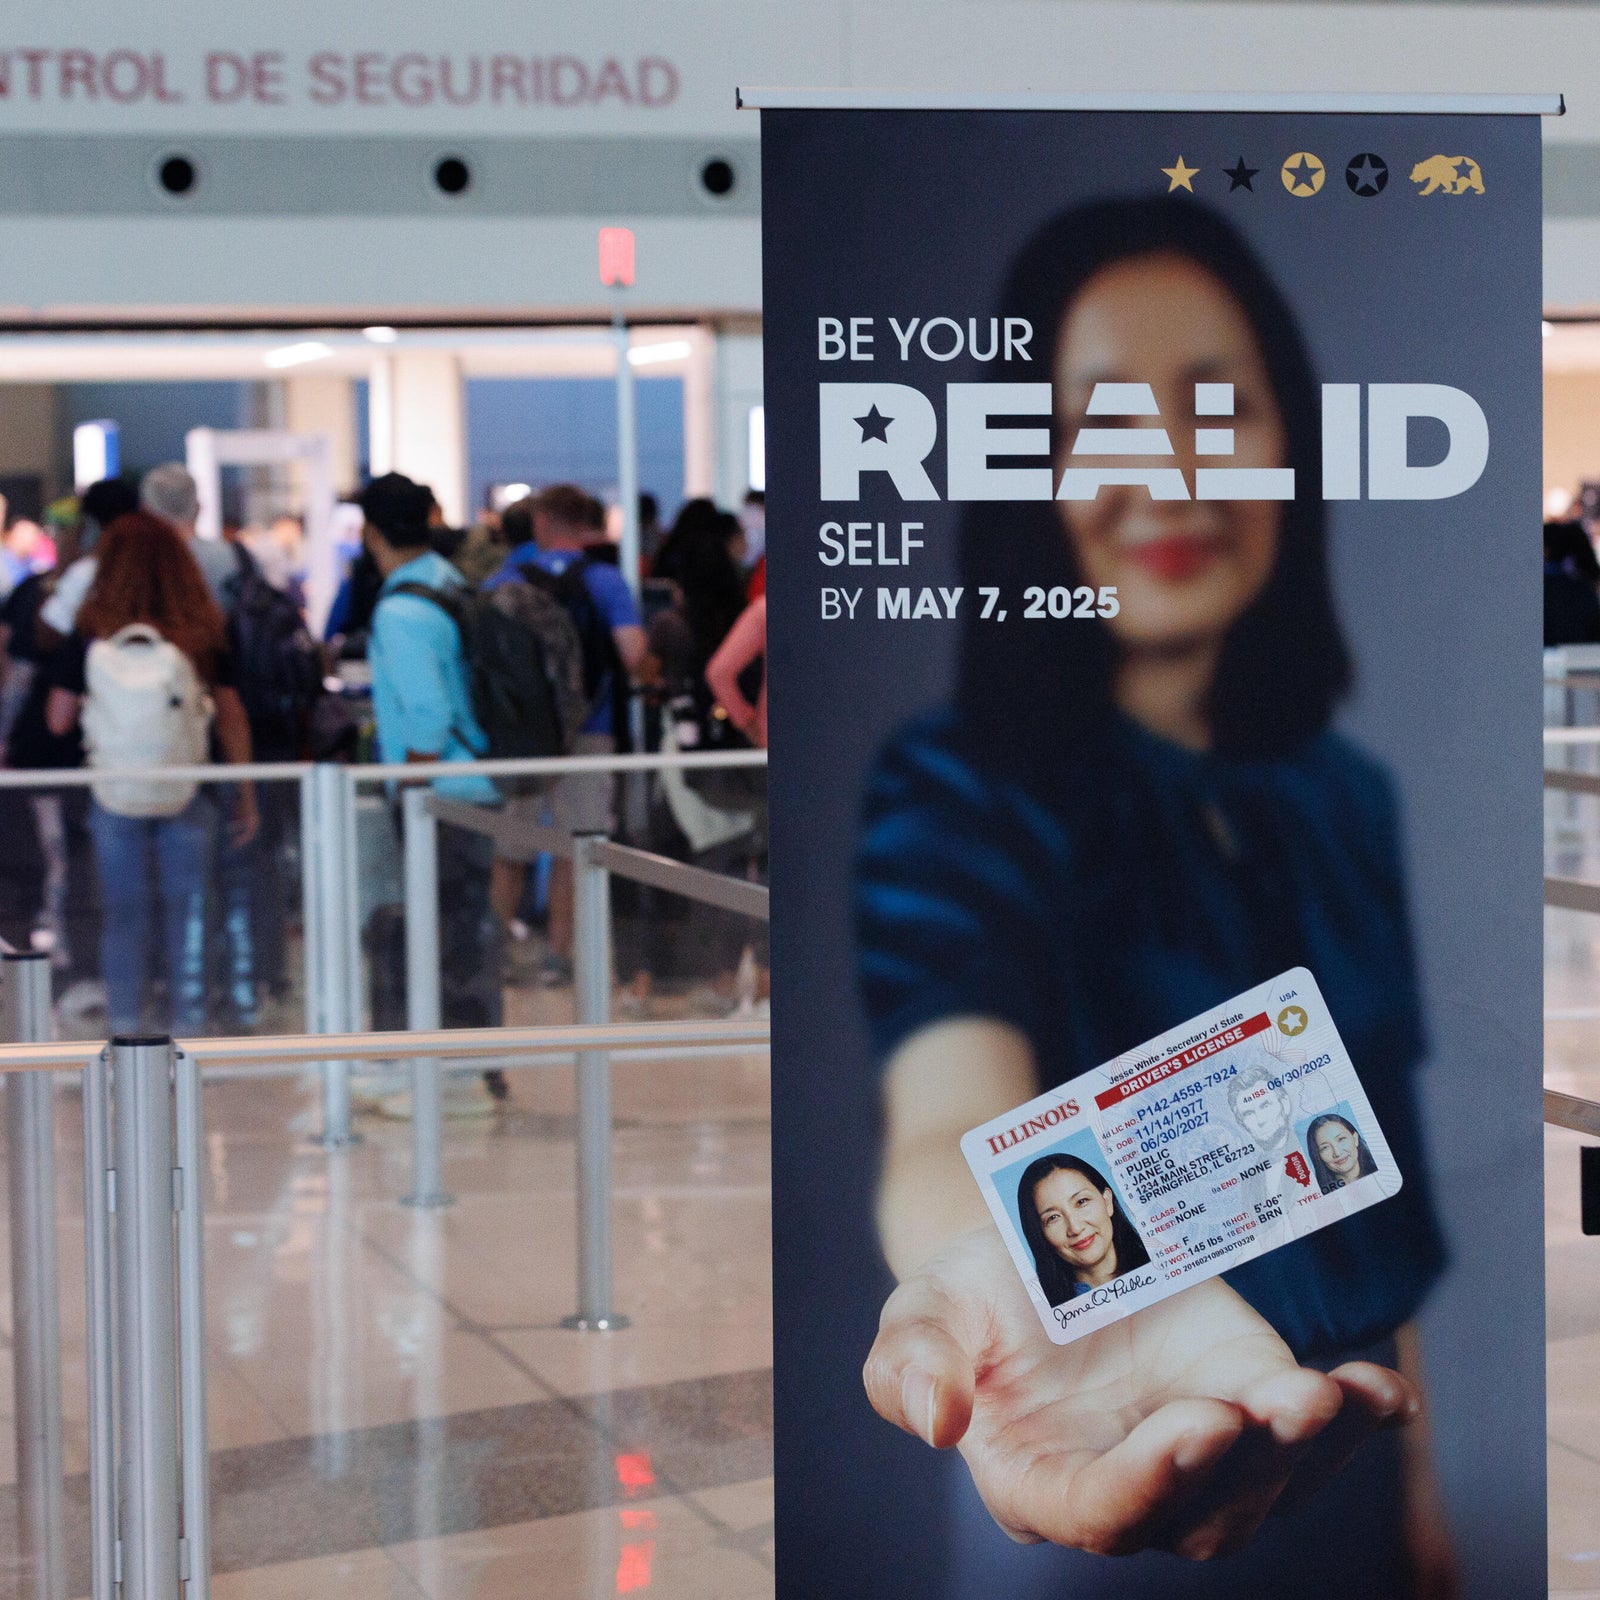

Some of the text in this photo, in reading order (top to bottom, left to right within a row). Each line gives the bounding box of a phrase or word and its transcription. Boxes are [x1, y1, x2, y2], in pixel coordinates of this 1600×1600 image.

[0, 47, 681, 108] TROL DE SEGURIDAD
[818, 316, 1034, 362] BE YOUR
[819, 382, 1490, 501] REAL ID
[818, 521, 925, 566] SELF
[820, 585, 1121, 622] BY MAY 7, 2025
[1278, 989, 1298, 1003] USA
[1107, 1011, 1244, 1085] Jesse White Secretary of State
[1118, 1027, 1244, 1097] DRIVER'S LICENSE
[1265, 1053, 1332, 1091] 06/30/2023
[1110, 1124, 1124, 1135] LIC
[1136, 1063, 1238, 1121] P142-4558-7924
[985, 1097, 1081, 1155] ILLINOIS
[1134, 1097, 1206, 1140] 11/14/1977
[1139, 1110, 1212, 1153] 06/30/2027
[1125, 1147, 1171, 1176] PUBLIC
[1129, 1163, 1163, 1186] JANE
[1163, 1157, 1176, 1170] Q
[1135, 1178, 1159, 1196] 1234
[1159, 1164, 1188, 1184] MAIN
[1188, 1143, 1231, 1170] STREET
[1138, 1142, 1256, 1205] SPRINGFIELD, IL 62723
[1239, 1159, 1272, 1181] NONE
[1290, 1155, 1307, 1180] DONOR
[1176, 1199, 1187, 1210] D
[1320, 1177, 1346, 1195] ORG
[1145, 1229, 1155, 1238] 12
[1174, 1202, 1207, 1224] NONE
[1257, 1206, 1283, 1224] BRN
[1155, 1250, 1164, 1258] 15
[1181, 1235, 1191, 1246] F
[1159, 1260, 1169, 1269] 17
[1187, 1241, 1206, 1256] 145
[1206, 1232, 1224, 1247] lbs
[1169, 1267, 1182, 1278] DD
[1053, 1274, 1157, 1329] Jane Q Public
